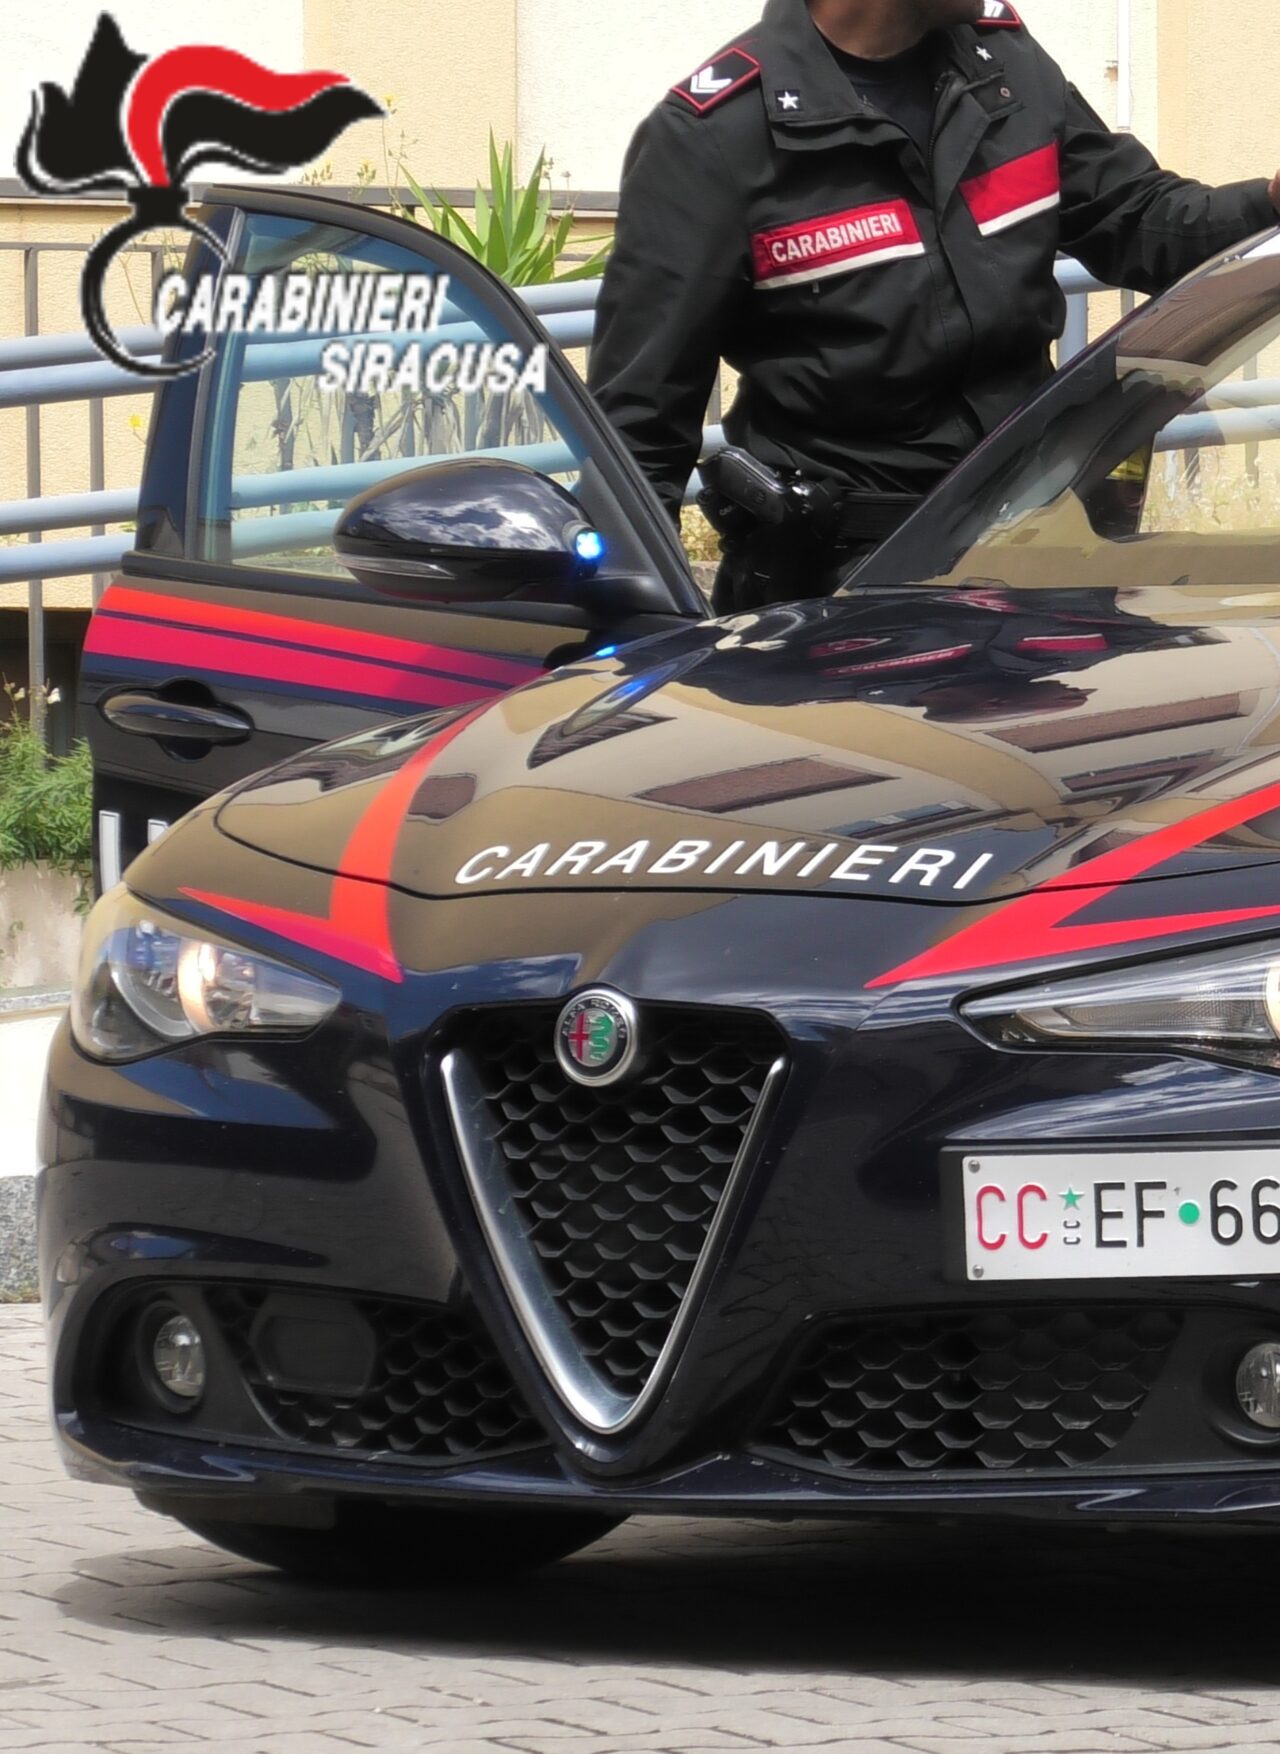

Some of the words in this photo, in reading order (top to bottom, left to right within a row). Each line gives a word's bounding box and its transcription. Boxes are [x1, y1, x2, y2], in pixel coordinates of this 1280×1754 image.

[771, 212, 902, 264] CARABINIERI
[454, 840, 993, 890] CARABINIERI
[975, 1184, 1049, 1250] CC
[1093, 1181, 1167, 1249] EF
